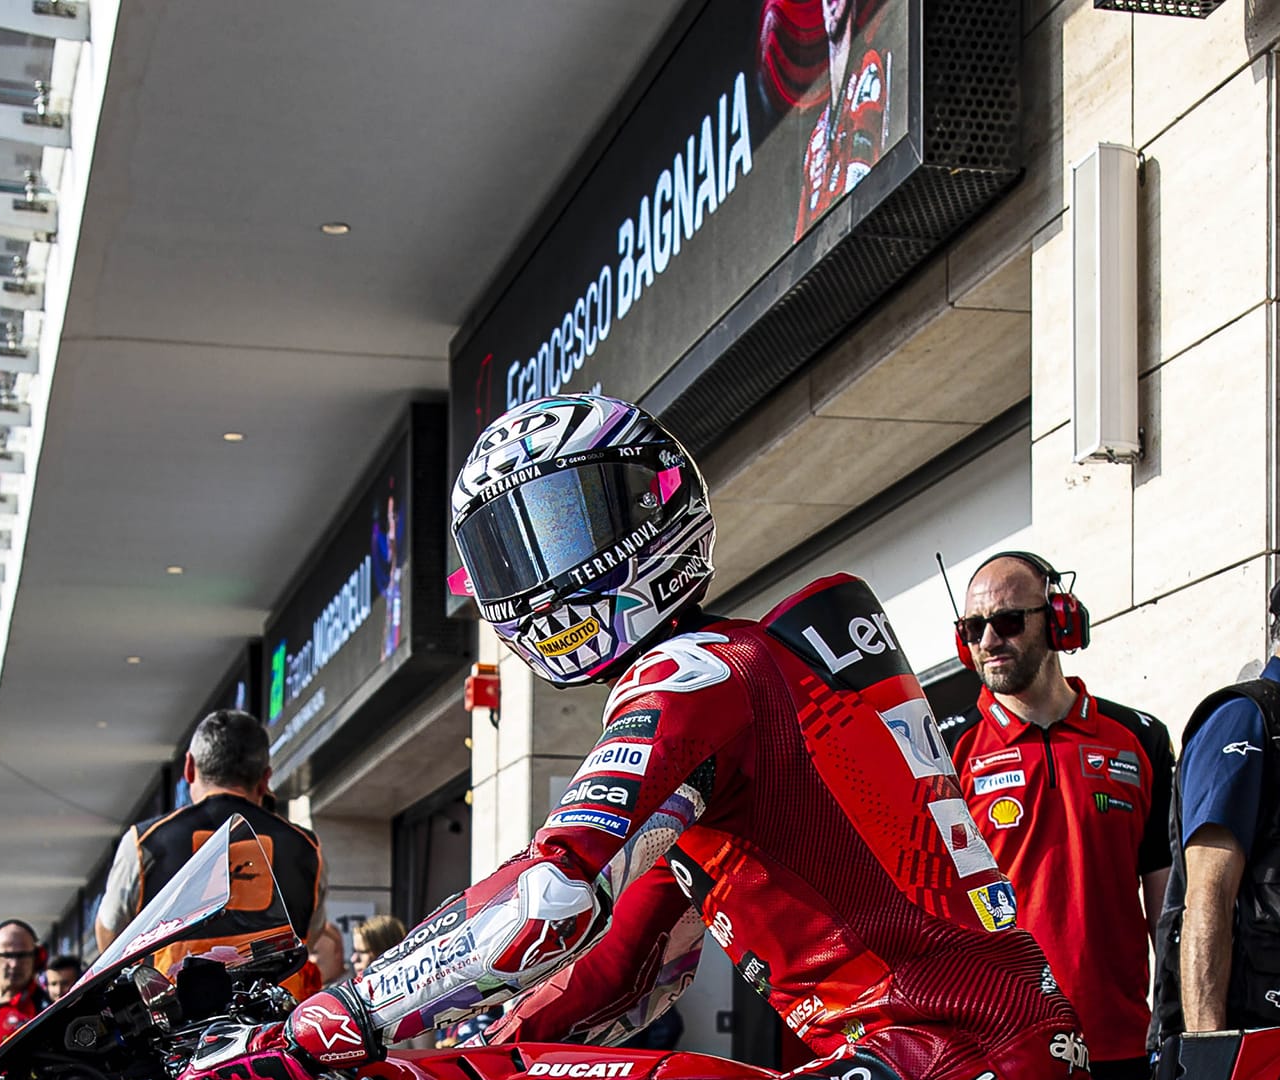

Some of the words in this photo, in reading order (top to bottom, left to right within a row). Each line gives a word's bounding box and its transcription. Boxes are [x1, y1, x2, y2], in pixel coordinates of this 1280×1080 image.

[505, 264, 613, 409] Francesco
[617, 71, 753, 319] BAGNAIA
[479, 465, 541, 503] TERRANOVA
[571, 520, 660, 584] TERRANOVA
[658, 554, 701, 600] Lenovo
[481, 599, 516, 622] ANOVA
[539, 621, 596, 656] PARMACOTTO
[801, 611, 898, 674] Len
[589, 747, 643, 768] riello
[1109, 759, 1138, 773] Lenovo
[560, 780, 629, 806] elica
[989, 773, 1021, 787] riello
[562, 813, 622, 830] MICHELIN
[527, 1061, 634, 1079] DUCATI
